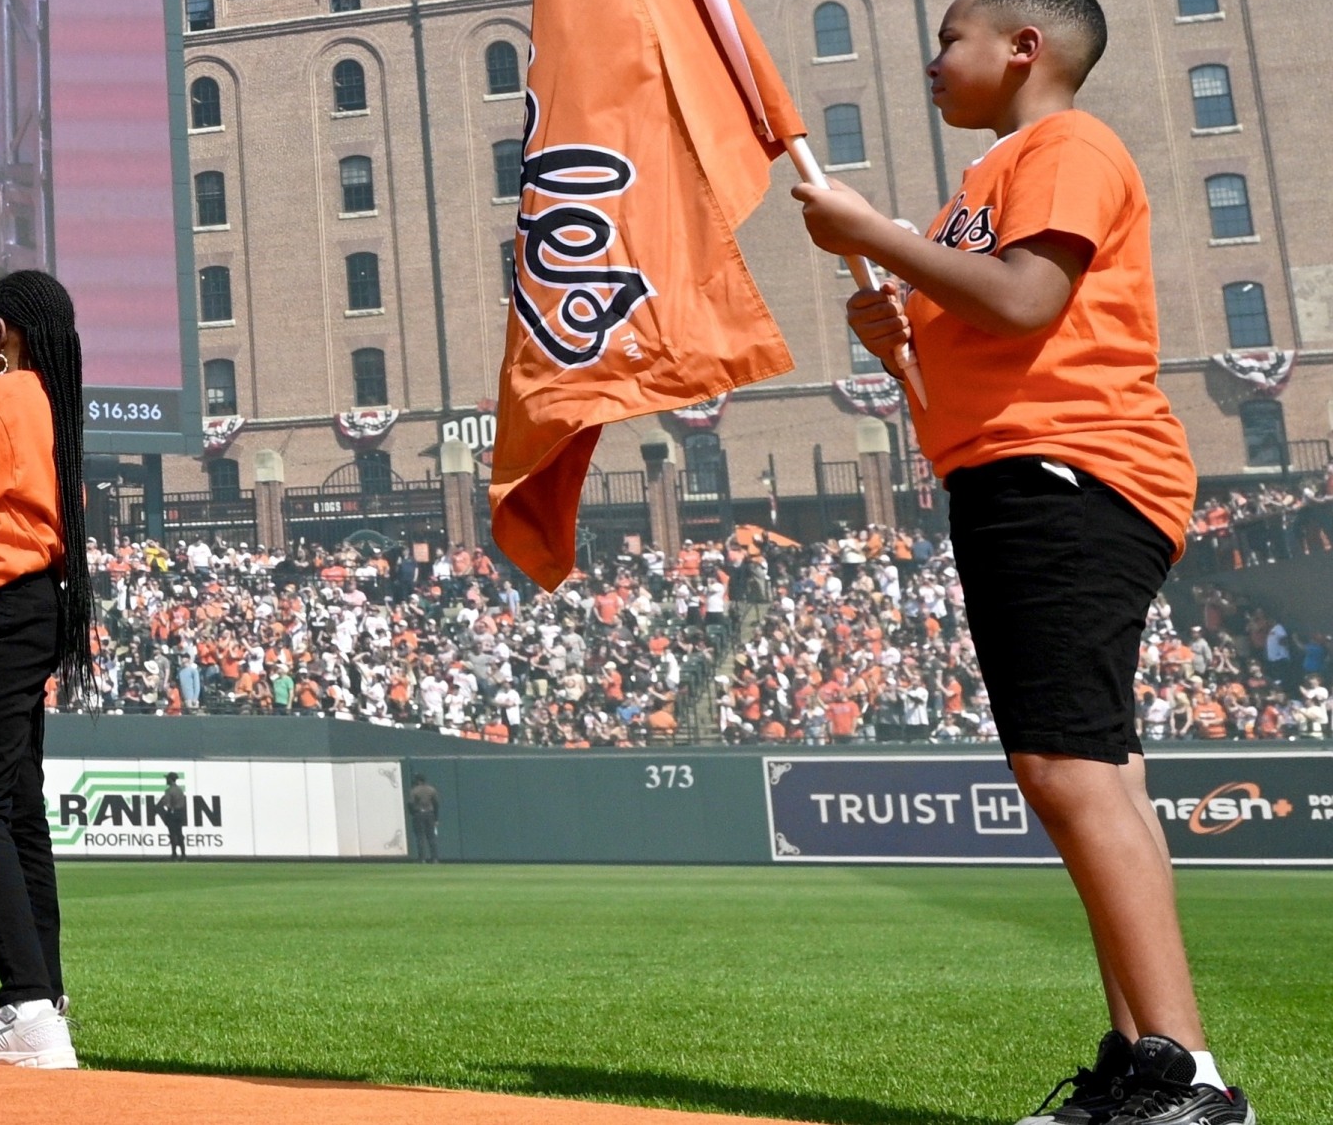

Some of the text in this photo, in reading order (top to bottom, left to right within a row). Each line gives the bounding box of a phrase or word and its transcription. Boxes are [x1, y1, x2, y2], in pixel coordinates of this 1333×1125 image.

[89, 399, 162, 421] $16,336
[645, 765, 694, 789] 373
[810, 793, 961, 824] TRUIST
[85, 833, 223, 847] ROOFING EXERTS
